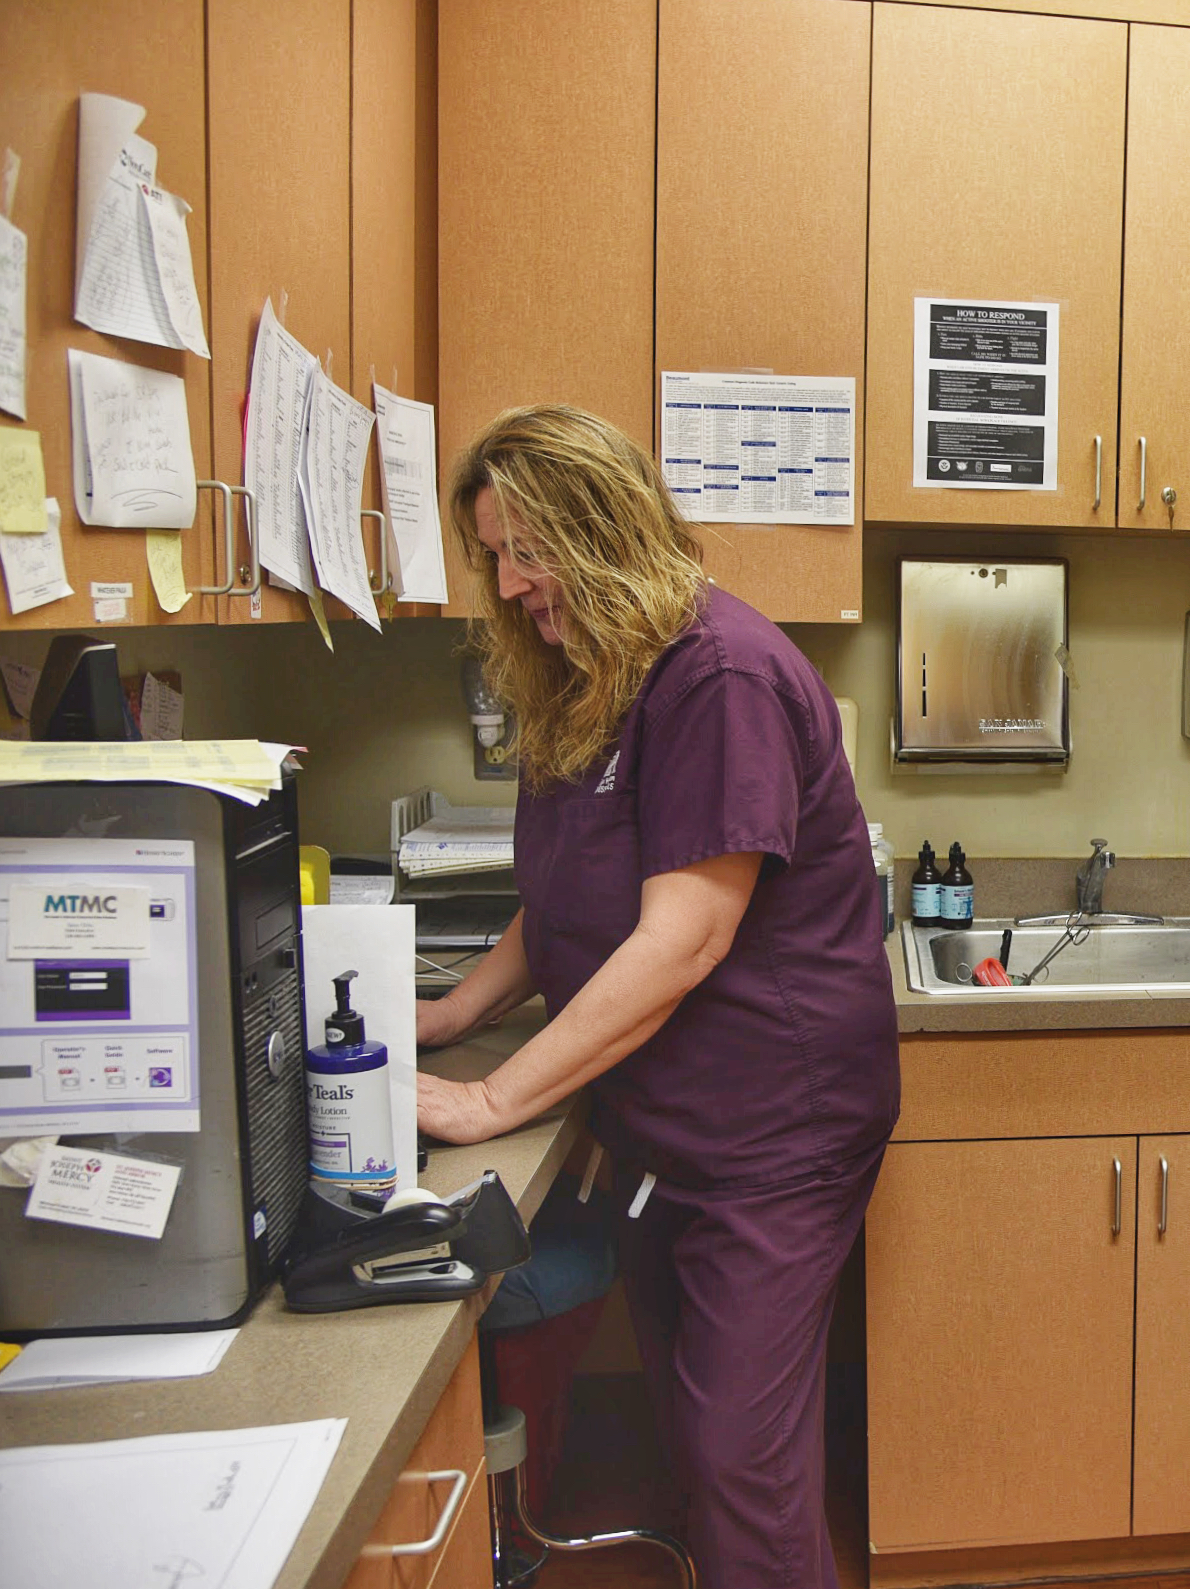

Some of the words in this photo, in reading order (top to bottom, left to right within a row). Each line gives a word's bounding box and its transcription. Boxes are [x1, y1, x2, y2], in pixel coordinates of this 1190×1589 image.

[957, 310, 976, 318] HOW
[977, 311, 988, 319] TO
[989, 312, 1025, 320] RESPOND
[44, 895, 117, 913] MTMC
[313, 1083, 355, 1100] Teal's
[320, 1106, 348, 1116] Lotion
[50, 1160, 85, 1172] JOSEPH
[51, 1169, 97, 1183] MERCY
